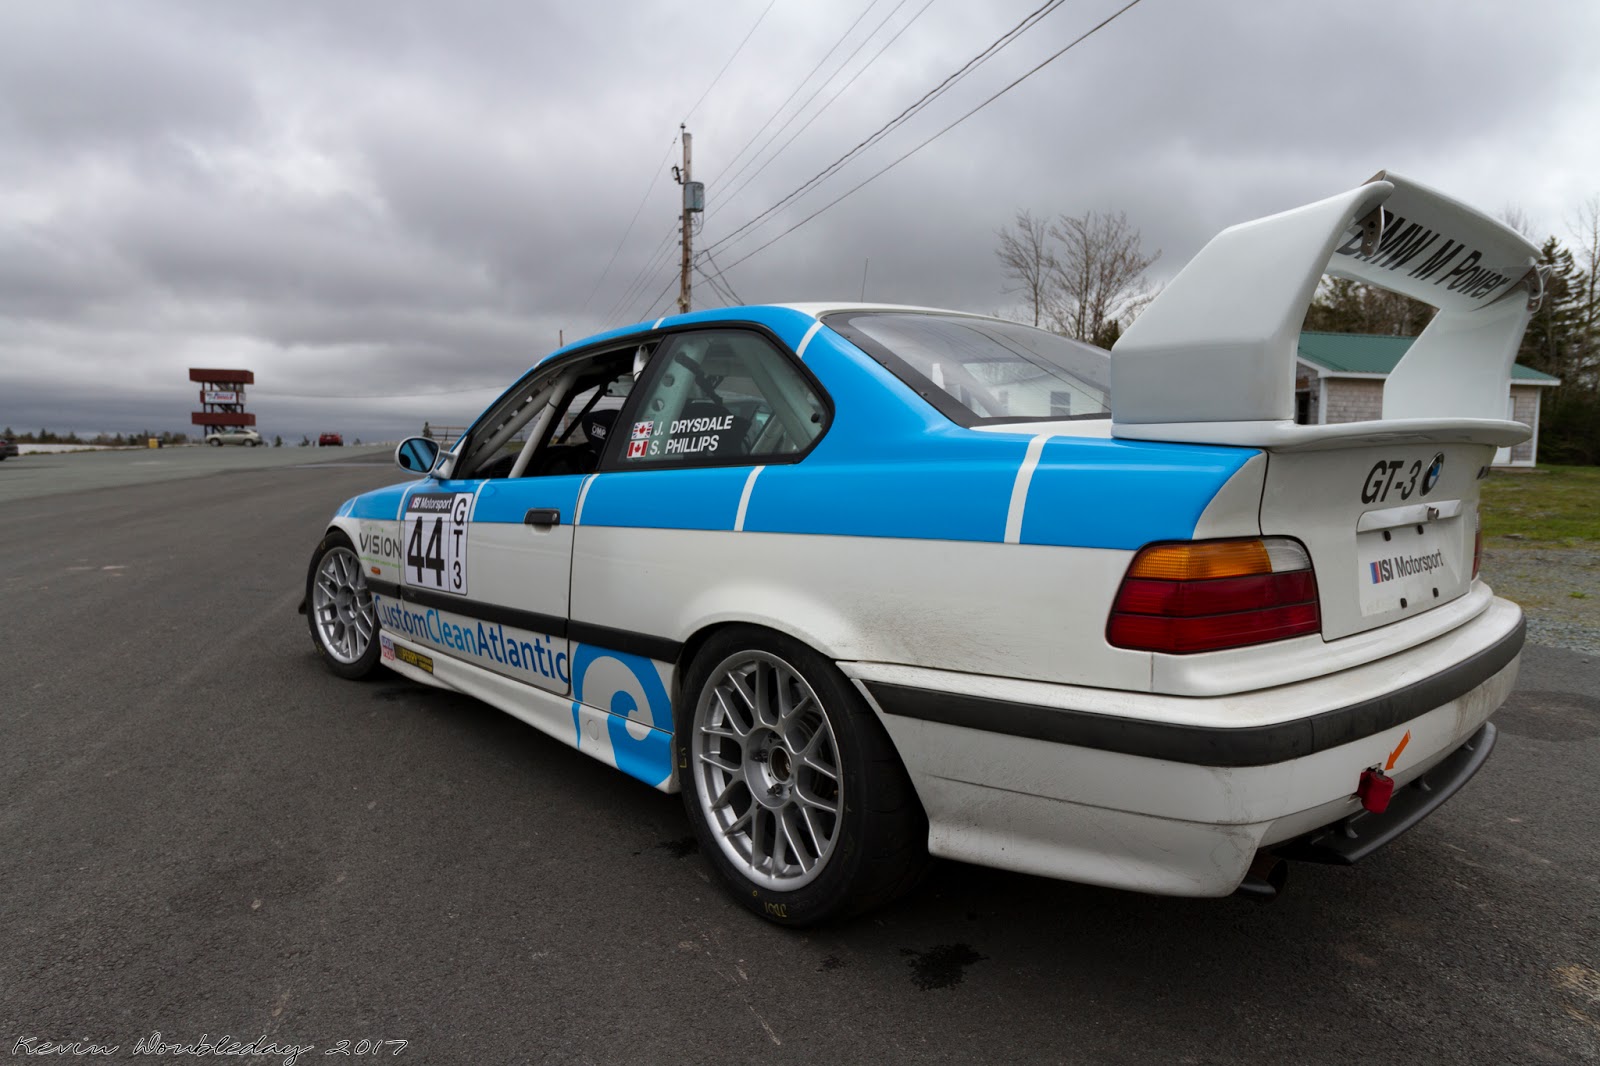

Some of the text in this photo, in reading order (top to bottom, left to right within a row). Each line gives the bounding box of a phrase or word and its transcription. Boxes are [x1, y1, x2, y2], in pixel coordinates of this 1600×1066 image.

[1407, 238, 1466, 281] M
[1433, 250, 1511, 299] Power
[591, 425, 607, 437] OMP
[654, 415, 734, 436] J. DRYSDALE
[650, 435, 719, 455] S. PHILLIPS
[1361, 460, 1422, 504] GT-3
[420, 497, 452, 512] Motorsport
[407, 515, 445, 587] 44
[1394, 549, 1444, 578] Motorsport
[374, 595, 570, 684] CustomCleanAtlantic
